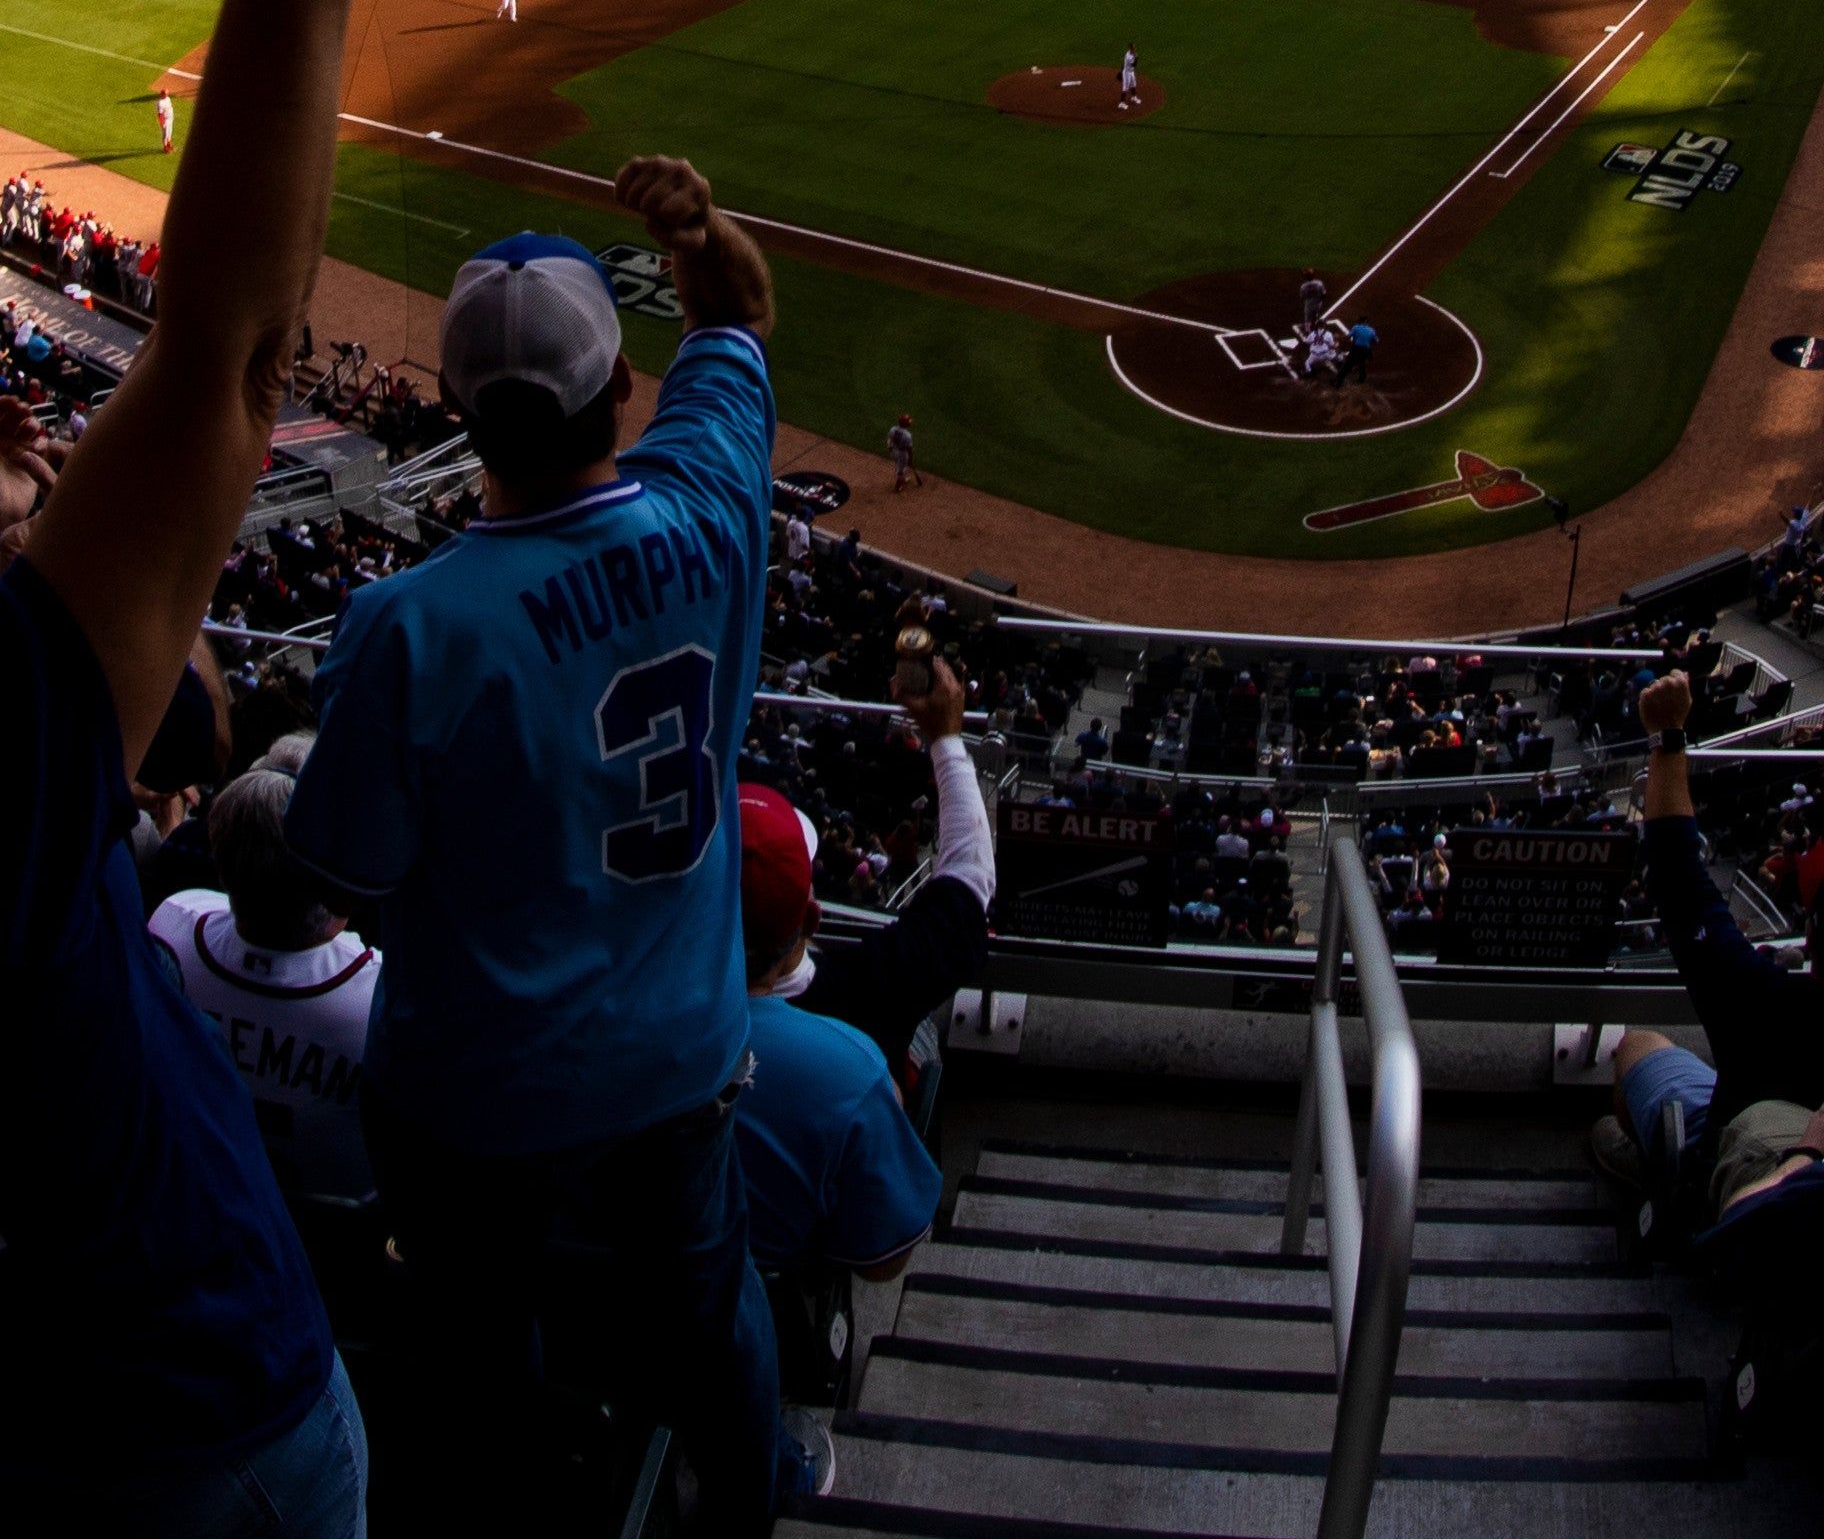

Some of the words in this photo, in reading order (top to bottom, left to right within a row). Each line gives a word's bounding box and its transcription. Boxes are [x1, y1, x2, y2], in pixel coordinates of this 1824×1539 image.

[1630, 130, 1730, 210] NLDS
[610, 270, 687, 321] DS
[519, 523, 741, 666] MURPHY
[594, 642, 721, 885] 3
[1010, 809, 1051, 835] BE
[1061, 813, 1158, 842] ALERT
[1472, 838, 1611, 863] CAUTION
[1461, 877, 1489, 890] DO
[1496, 878, 1532, 891] NOT
[1540, 879, 1569, 892] SIT
[1461, 894, 1511, 907] LEAN
[1517, 896, 1569, 909] OVER
[1576, 897, 1602, 910] OR
[1109, 909, 1151, 921] LEAVE
[1455, 911, 1515, 924] PLACE
[1521, 913, 1605, 926] OBJECTS
[1471, 928, 1499, 940] ON
[1505, 929, 1583, 942] RAILING
[1476, 945, 1504, 957] OR
[1509, 946, 1571, 959] LEDGE
